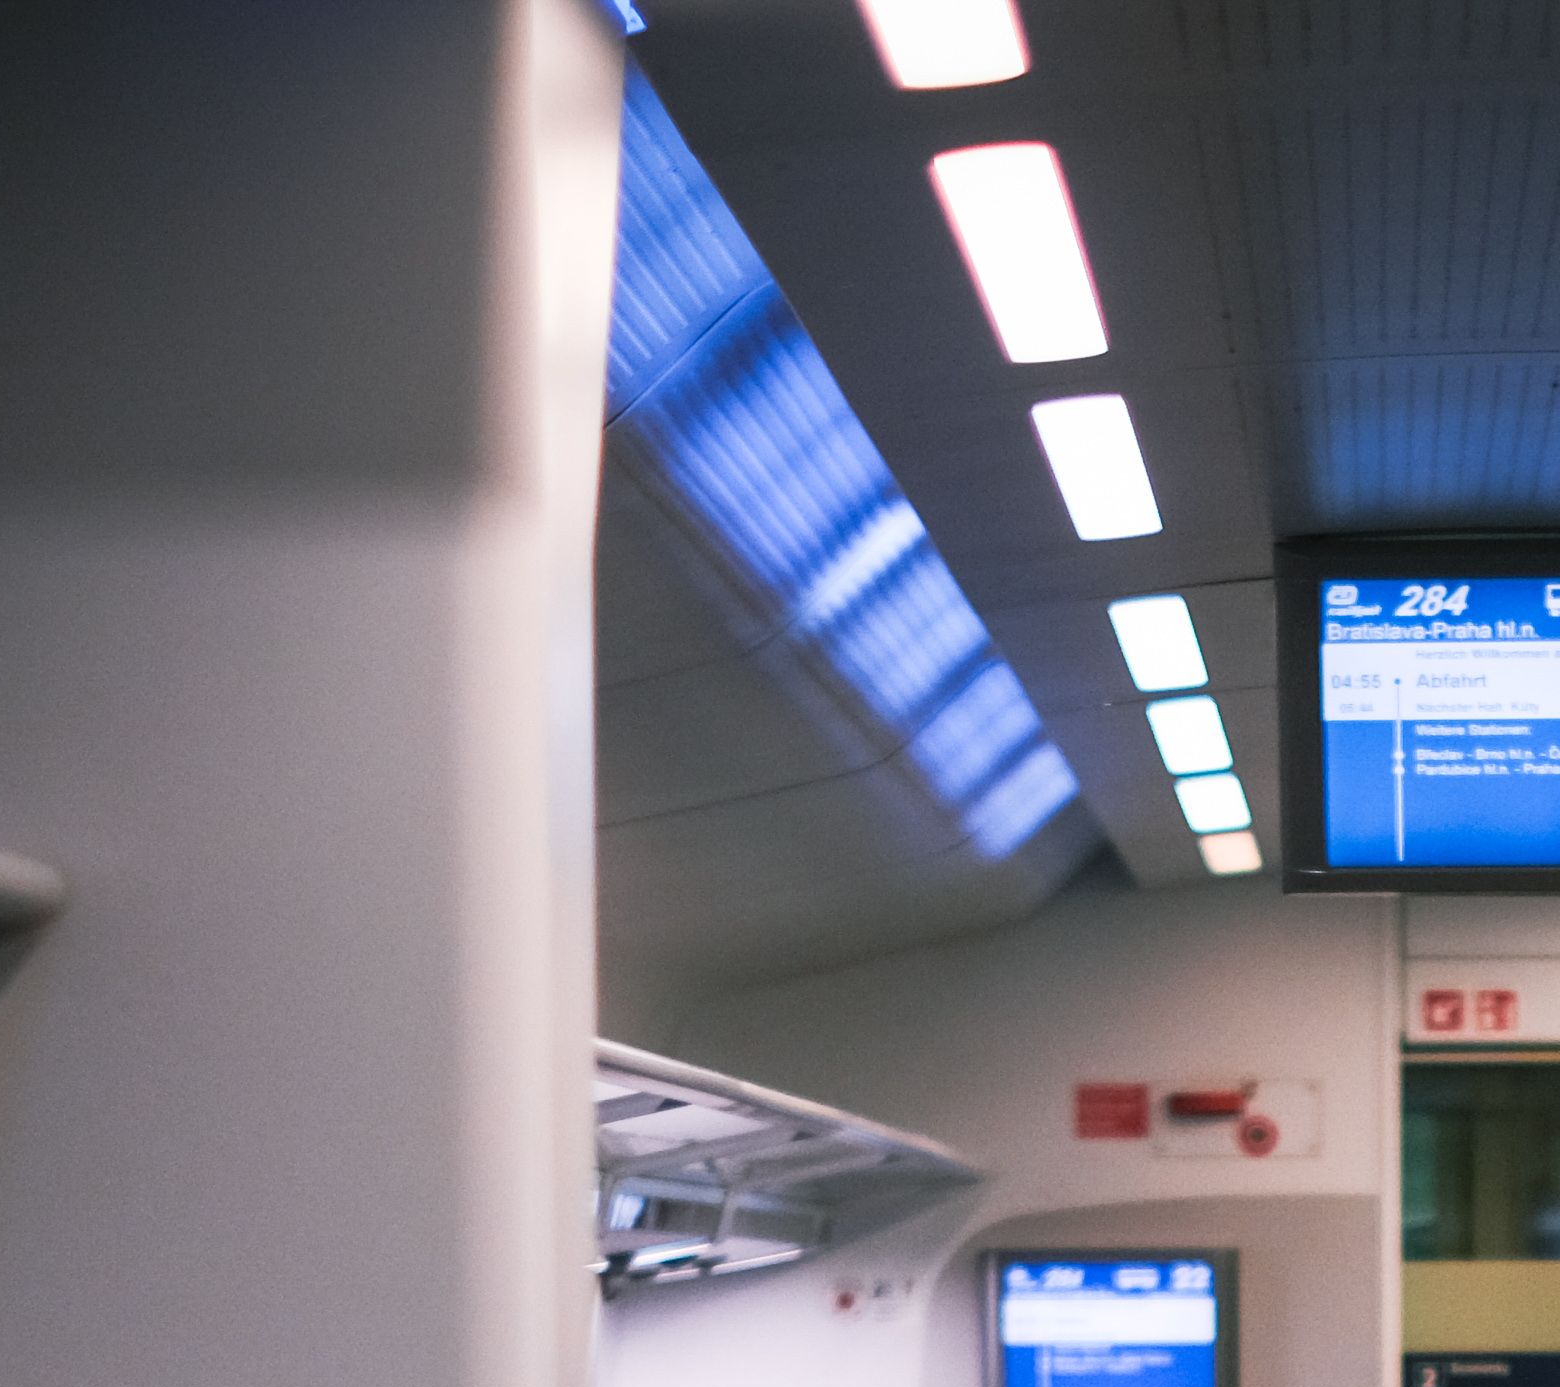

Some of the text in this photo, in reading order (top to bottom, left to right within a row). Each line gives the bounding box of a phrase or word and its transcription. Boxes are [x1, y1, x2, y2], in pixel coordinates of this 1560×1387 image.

[1394, 584, 1470, 617] 284
[1327, 620, 1539, 640] Bratislava-Praha hl.n.
[1331, 674, 1382, 689] 04:55
[1416, 673, 1488, 688] Abfahrt
